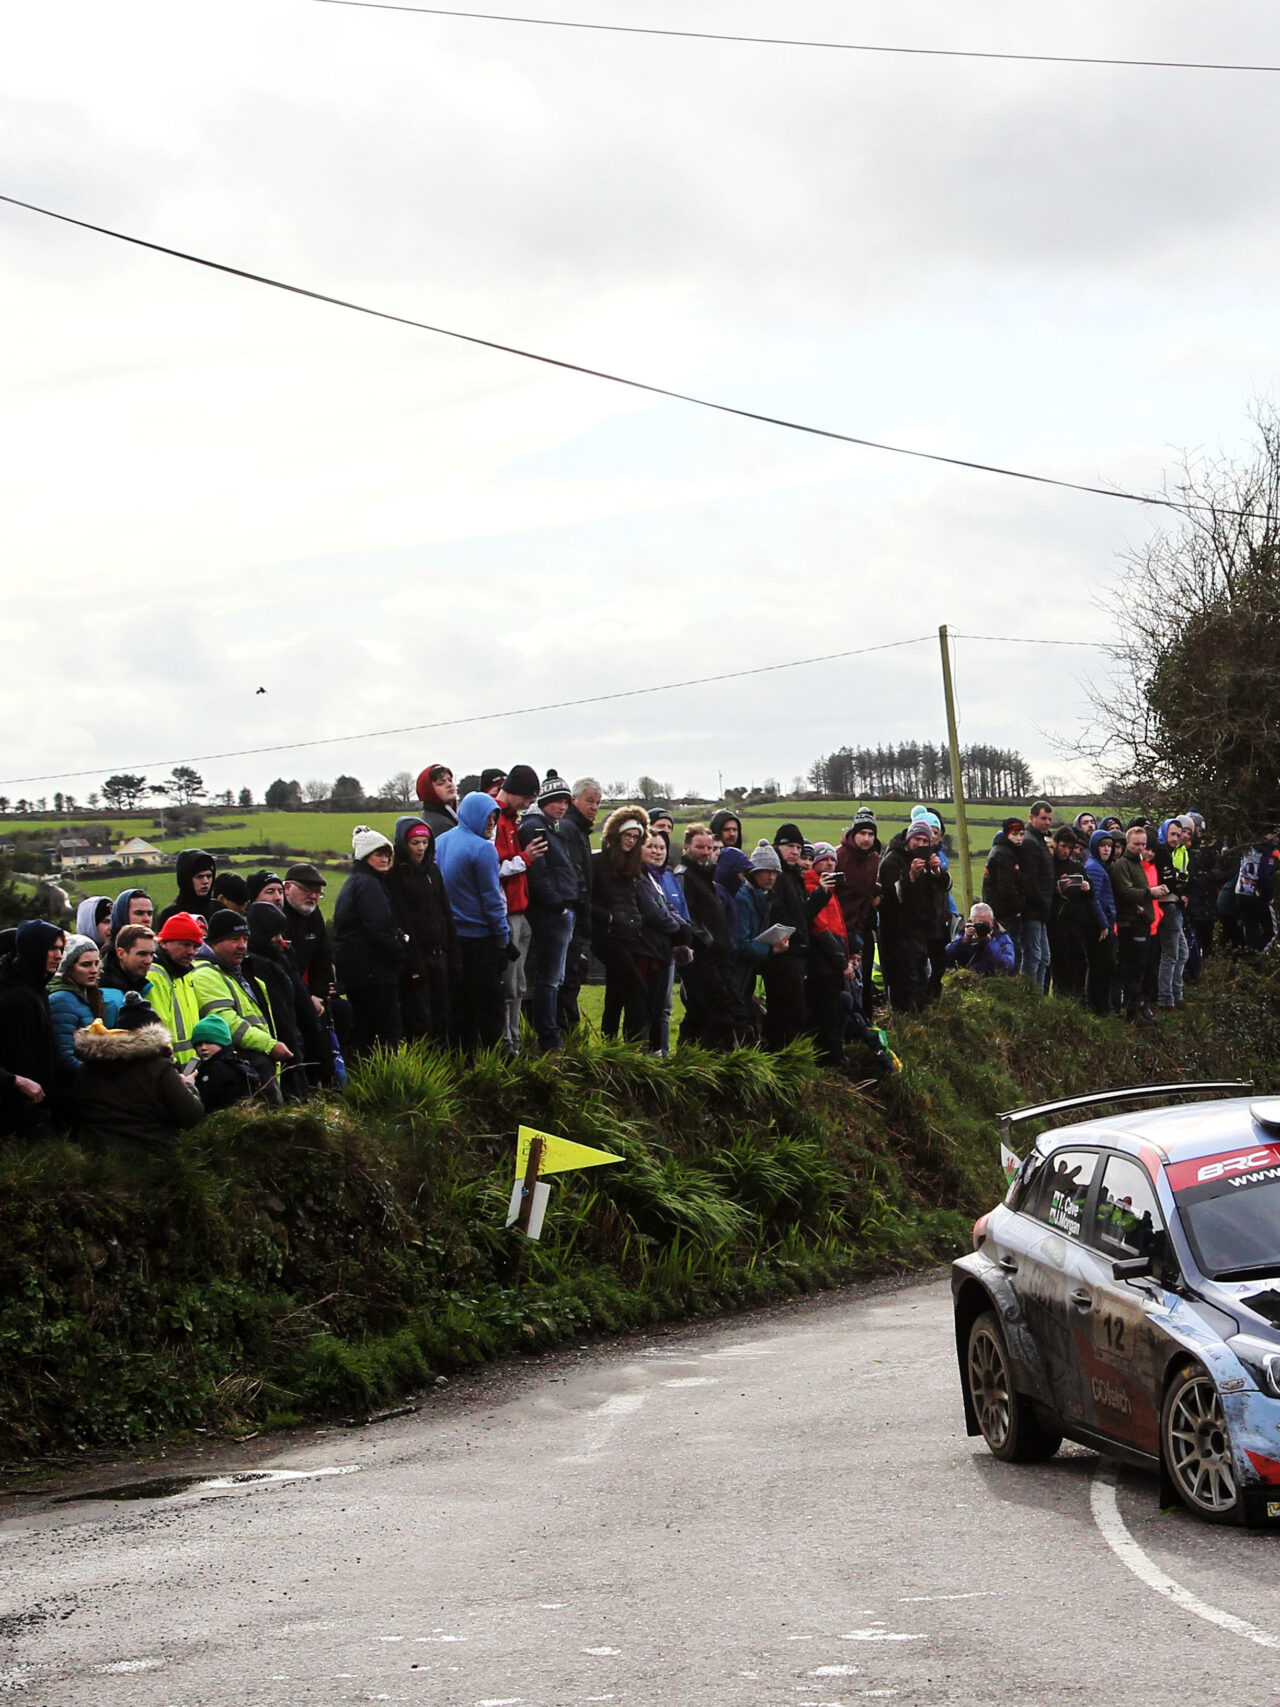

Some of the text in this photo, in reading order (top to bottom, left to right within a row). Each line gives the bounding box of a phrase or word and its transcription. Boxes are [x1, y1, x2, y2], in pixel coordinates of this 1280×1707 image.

[1197, 1149, 1272, 1182] BRC
[1065, 1197, 1079, 1217] Cave
[1104, 1312, 1125, 1352] 12
